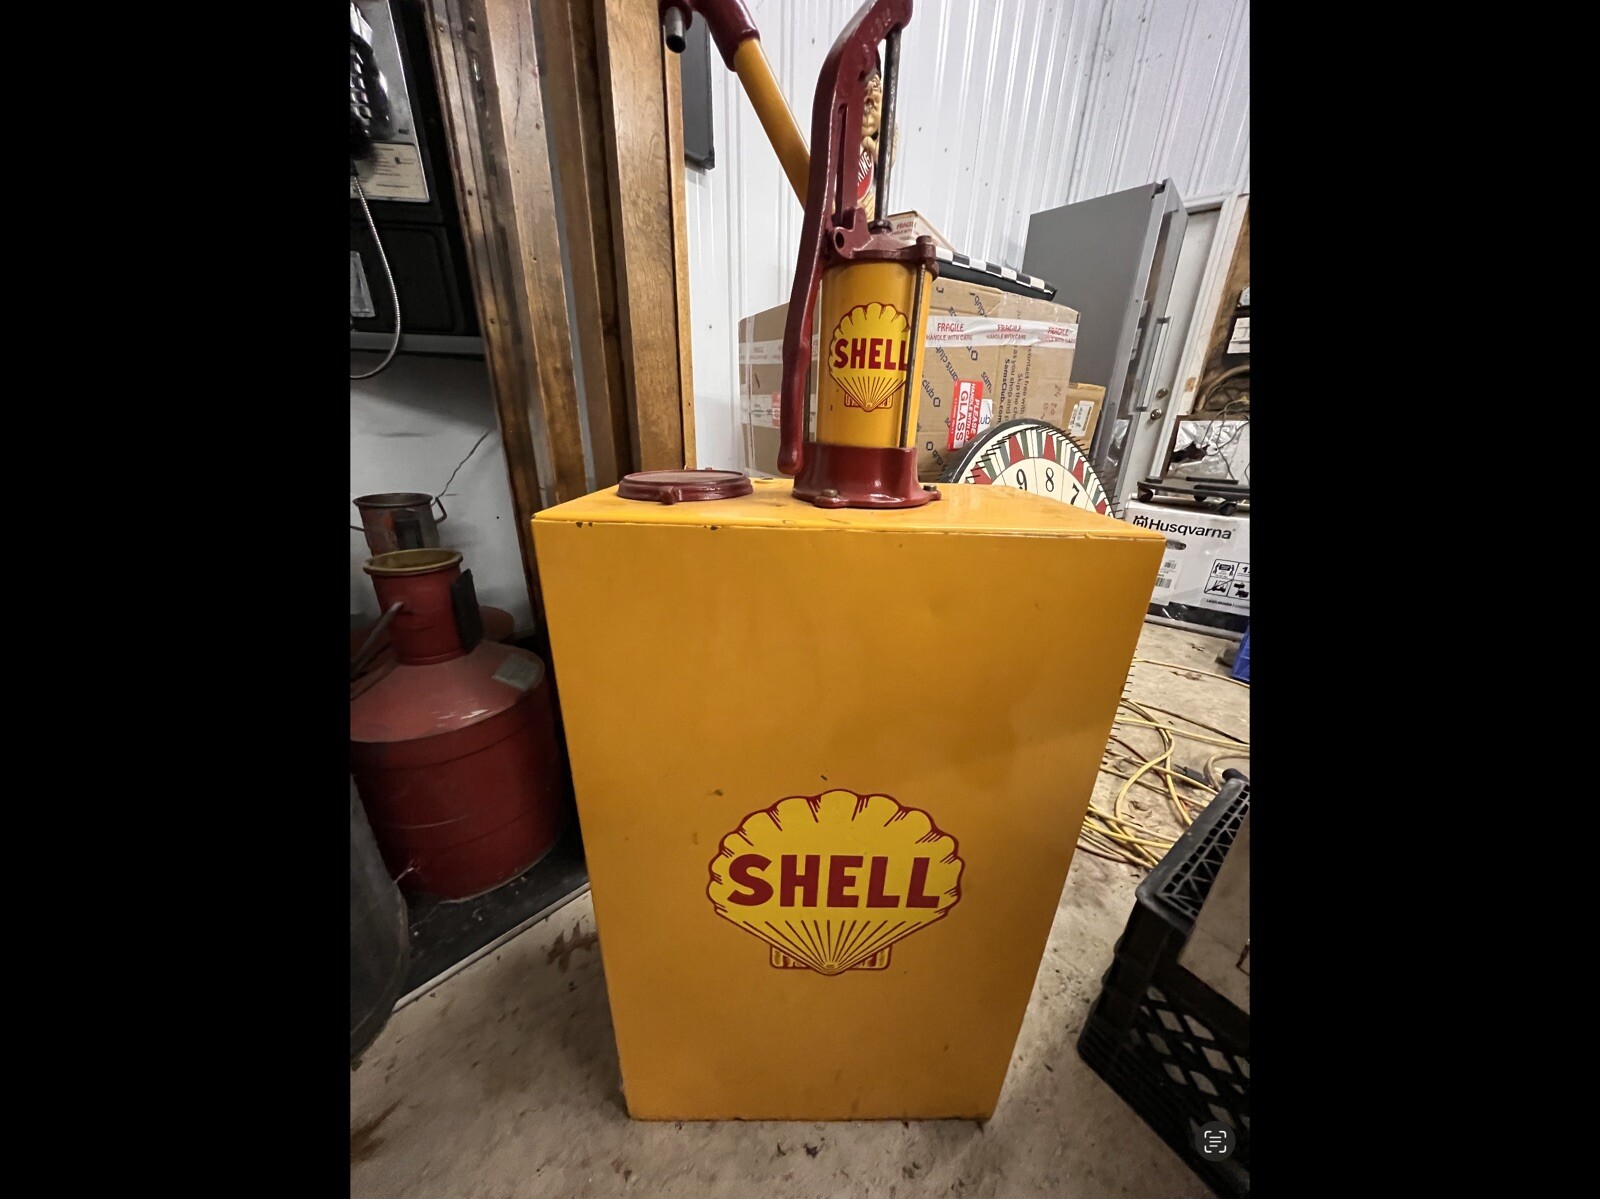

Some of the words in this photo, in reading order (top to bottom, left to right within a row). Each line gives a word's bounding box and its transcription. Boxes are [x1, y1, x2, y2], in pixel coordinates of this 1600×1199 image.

[937, 322, 964, 332] FRAGILE
[997, 324, 1022, 332] FRAGILE
[833, 338, 908, 371] SHELL
[1009, 359, 1017, 376] you
[922, 379, 934, 398] club
[968, 383, 977, 410] HANDLE
[956, 390, 968, 441] GLASS
[971, 399, 980, 434] PLEASE
[1016, 469, 1027, 491] 9
[1045, 467, 1054, 492] 8
[1070, 482, 1080, 505] 7
[1147, 518, 1232, 539] Husqvarna
[726, 853, 940, 908] SHELL
